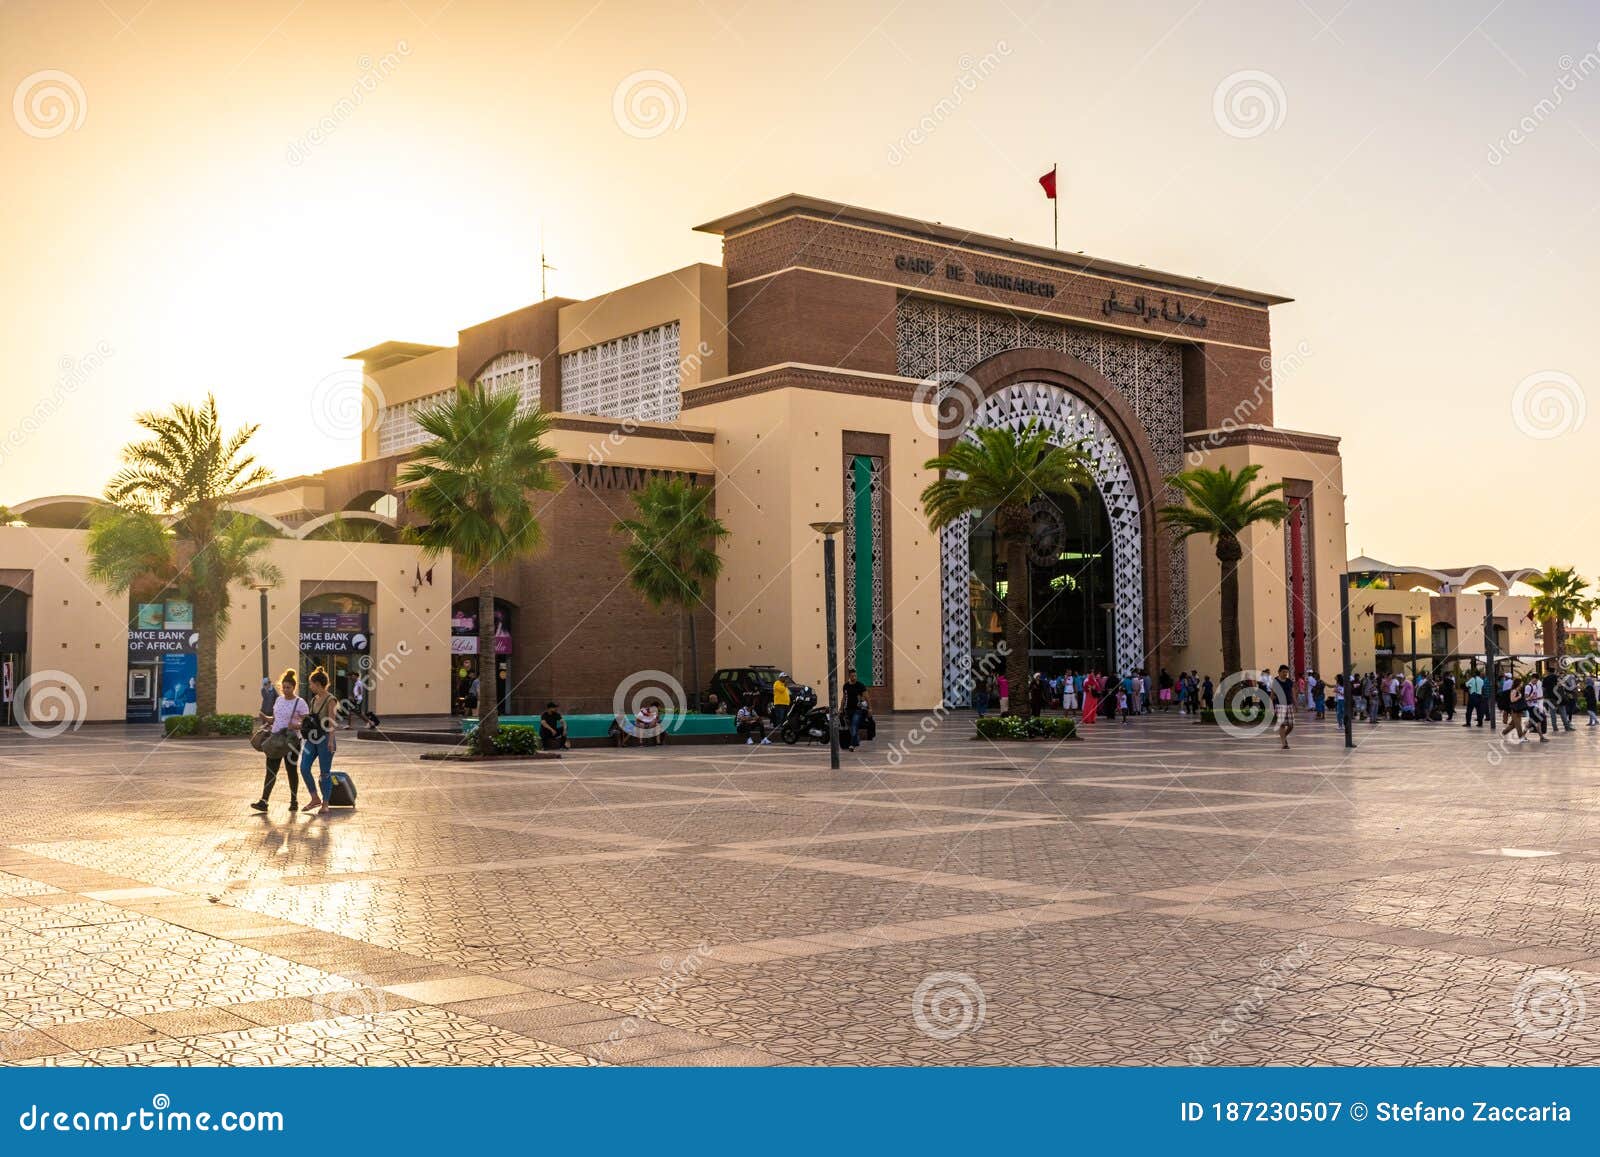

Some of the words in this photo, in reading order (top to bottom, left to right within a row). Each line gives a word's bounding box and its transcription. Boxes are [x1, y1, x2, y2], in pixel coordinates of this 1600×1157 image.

[895, 254, 936, 277] GARE
[945, 264, 965, 283] DE
[974, 270, 1057, 299] MARRAKECH
[1103, 289, 1158, 324] مراكش
[1161, 297, 1207, 328] محطة
[159, 631, 185, 640] BANK
[325, 633, 349, 641] BANK
[130, 642, 144, 650] OF
[147, 642, 183, 650] AFRICA
[300, 642, 312, 650] OF
